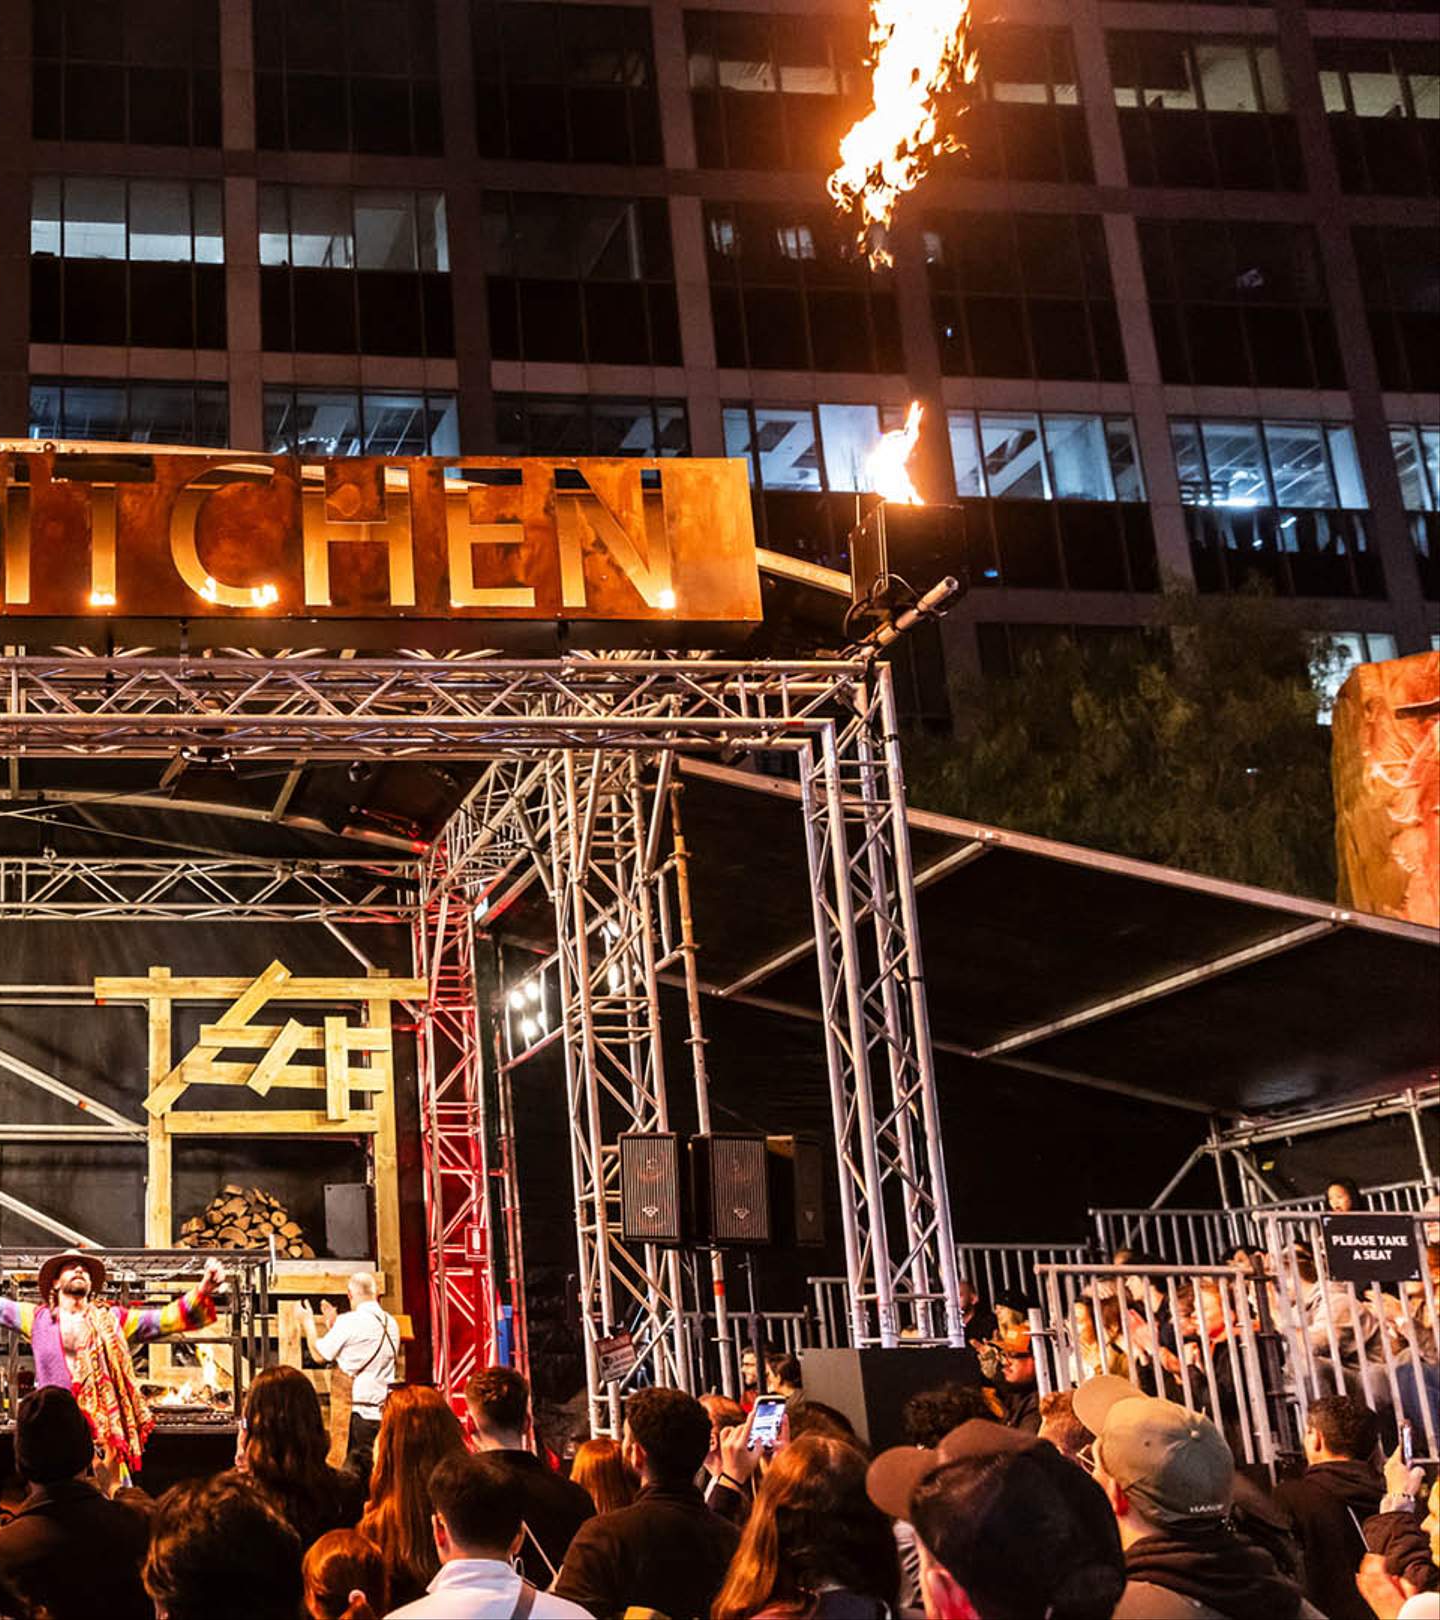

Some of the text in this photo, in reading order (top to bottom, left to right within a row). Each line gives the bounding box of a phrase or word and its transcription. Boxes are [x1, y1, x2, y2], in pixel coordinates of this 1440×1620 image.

[1331, 1235, 1408, 1246] PLEASE TAKE
[1353, 1250, 1392, 1260] A SEAT
